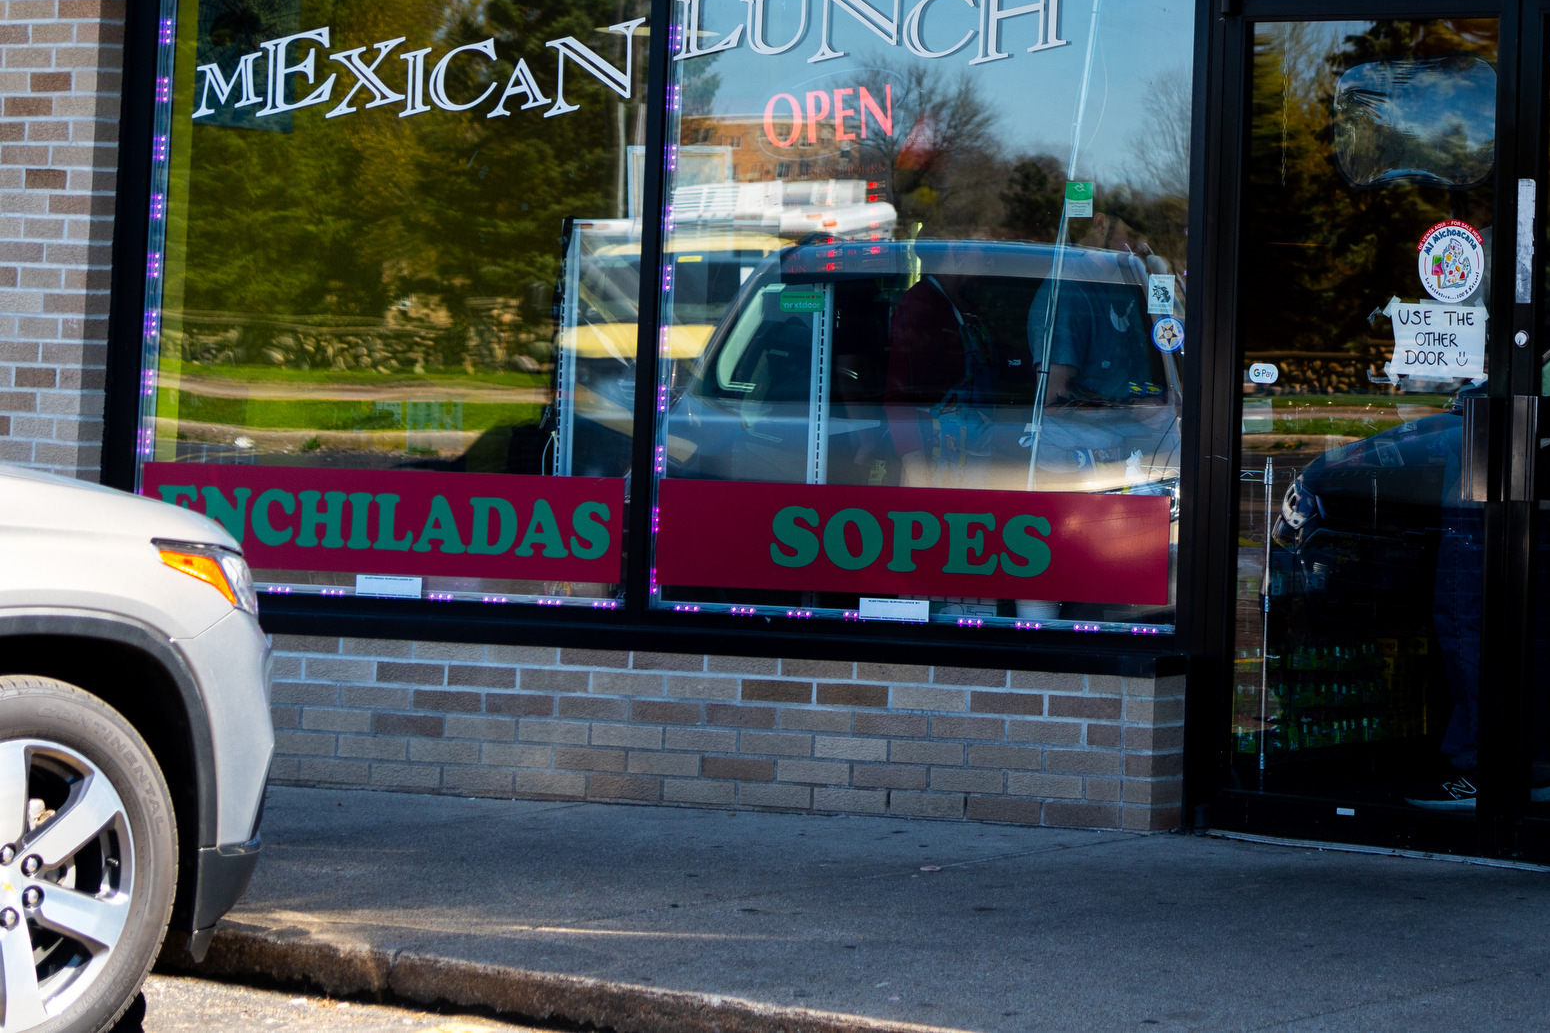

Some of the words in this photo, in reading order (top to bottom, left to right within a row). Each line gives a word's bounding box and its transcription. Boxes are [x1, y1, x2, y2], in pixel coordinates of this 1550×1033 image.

[191, 17, 647, 119] MEXICAN
[763, 84, 894, 148] OPEN
[1398, 309, 1432, 326] USE
[1443, 311, 1475, 327] THE
[1414, 332, 1459, 348] OTHER
[1404, 350, 1449, 366] DOOR
[1261, 368, 1275, 380] Pay
[769, 505, 1052, 579] SOPES
